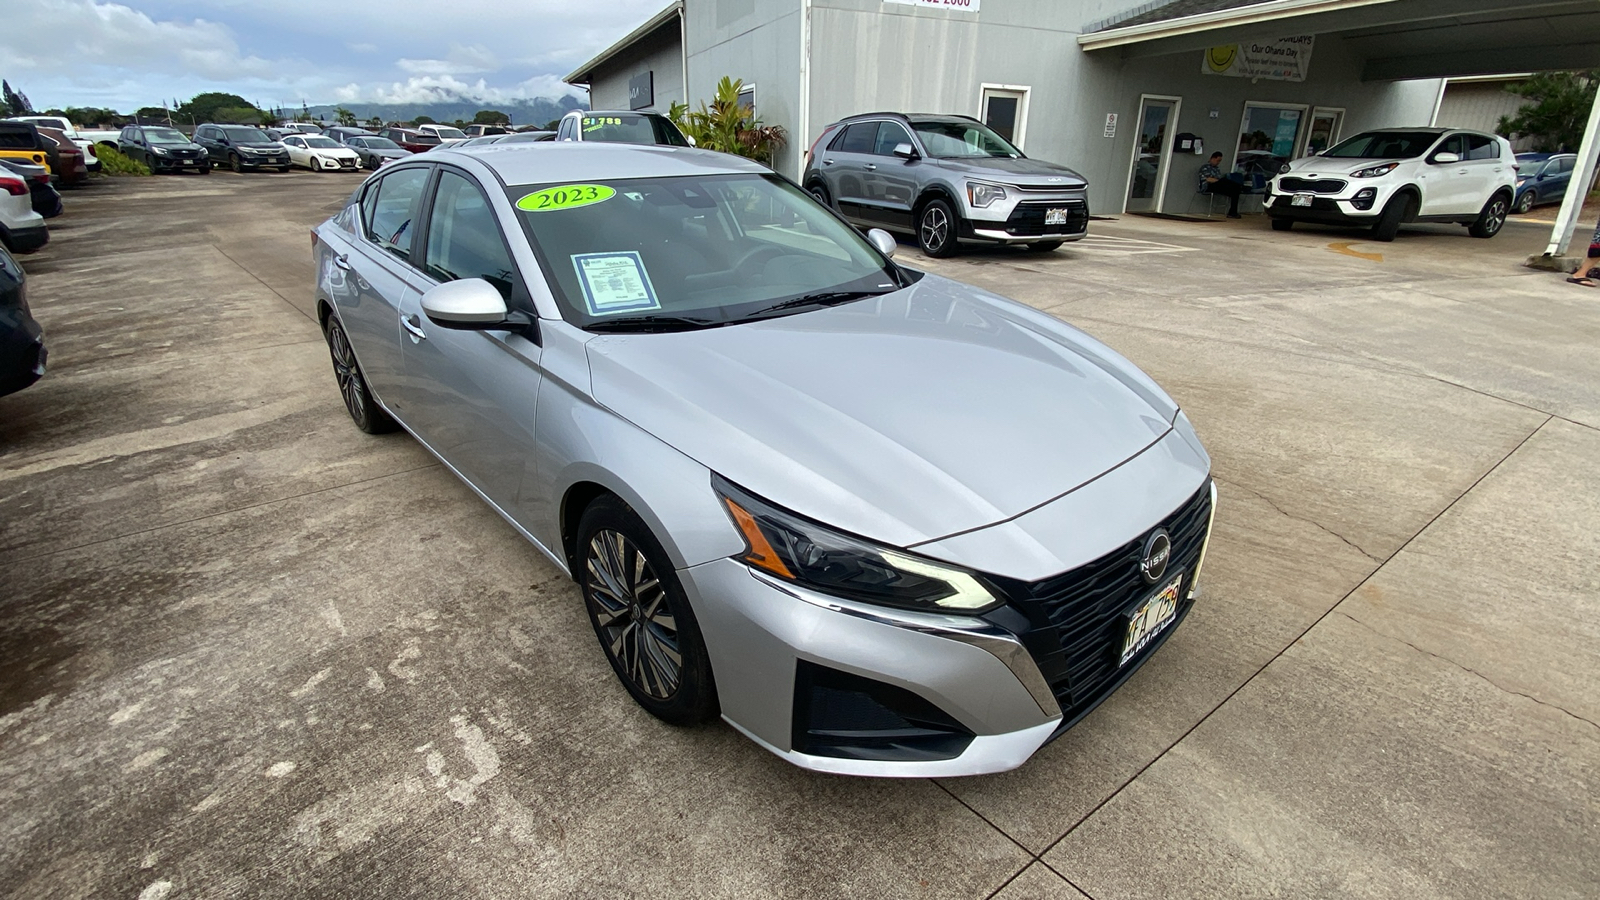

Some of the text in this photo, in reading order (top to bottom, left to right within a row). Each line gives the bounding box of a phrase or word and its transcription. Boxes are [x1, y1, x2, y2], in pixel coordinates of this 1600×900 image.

[1251, 44, 1298, 57] Our Ohana Day
[537, 186, 599, 209] 2023
